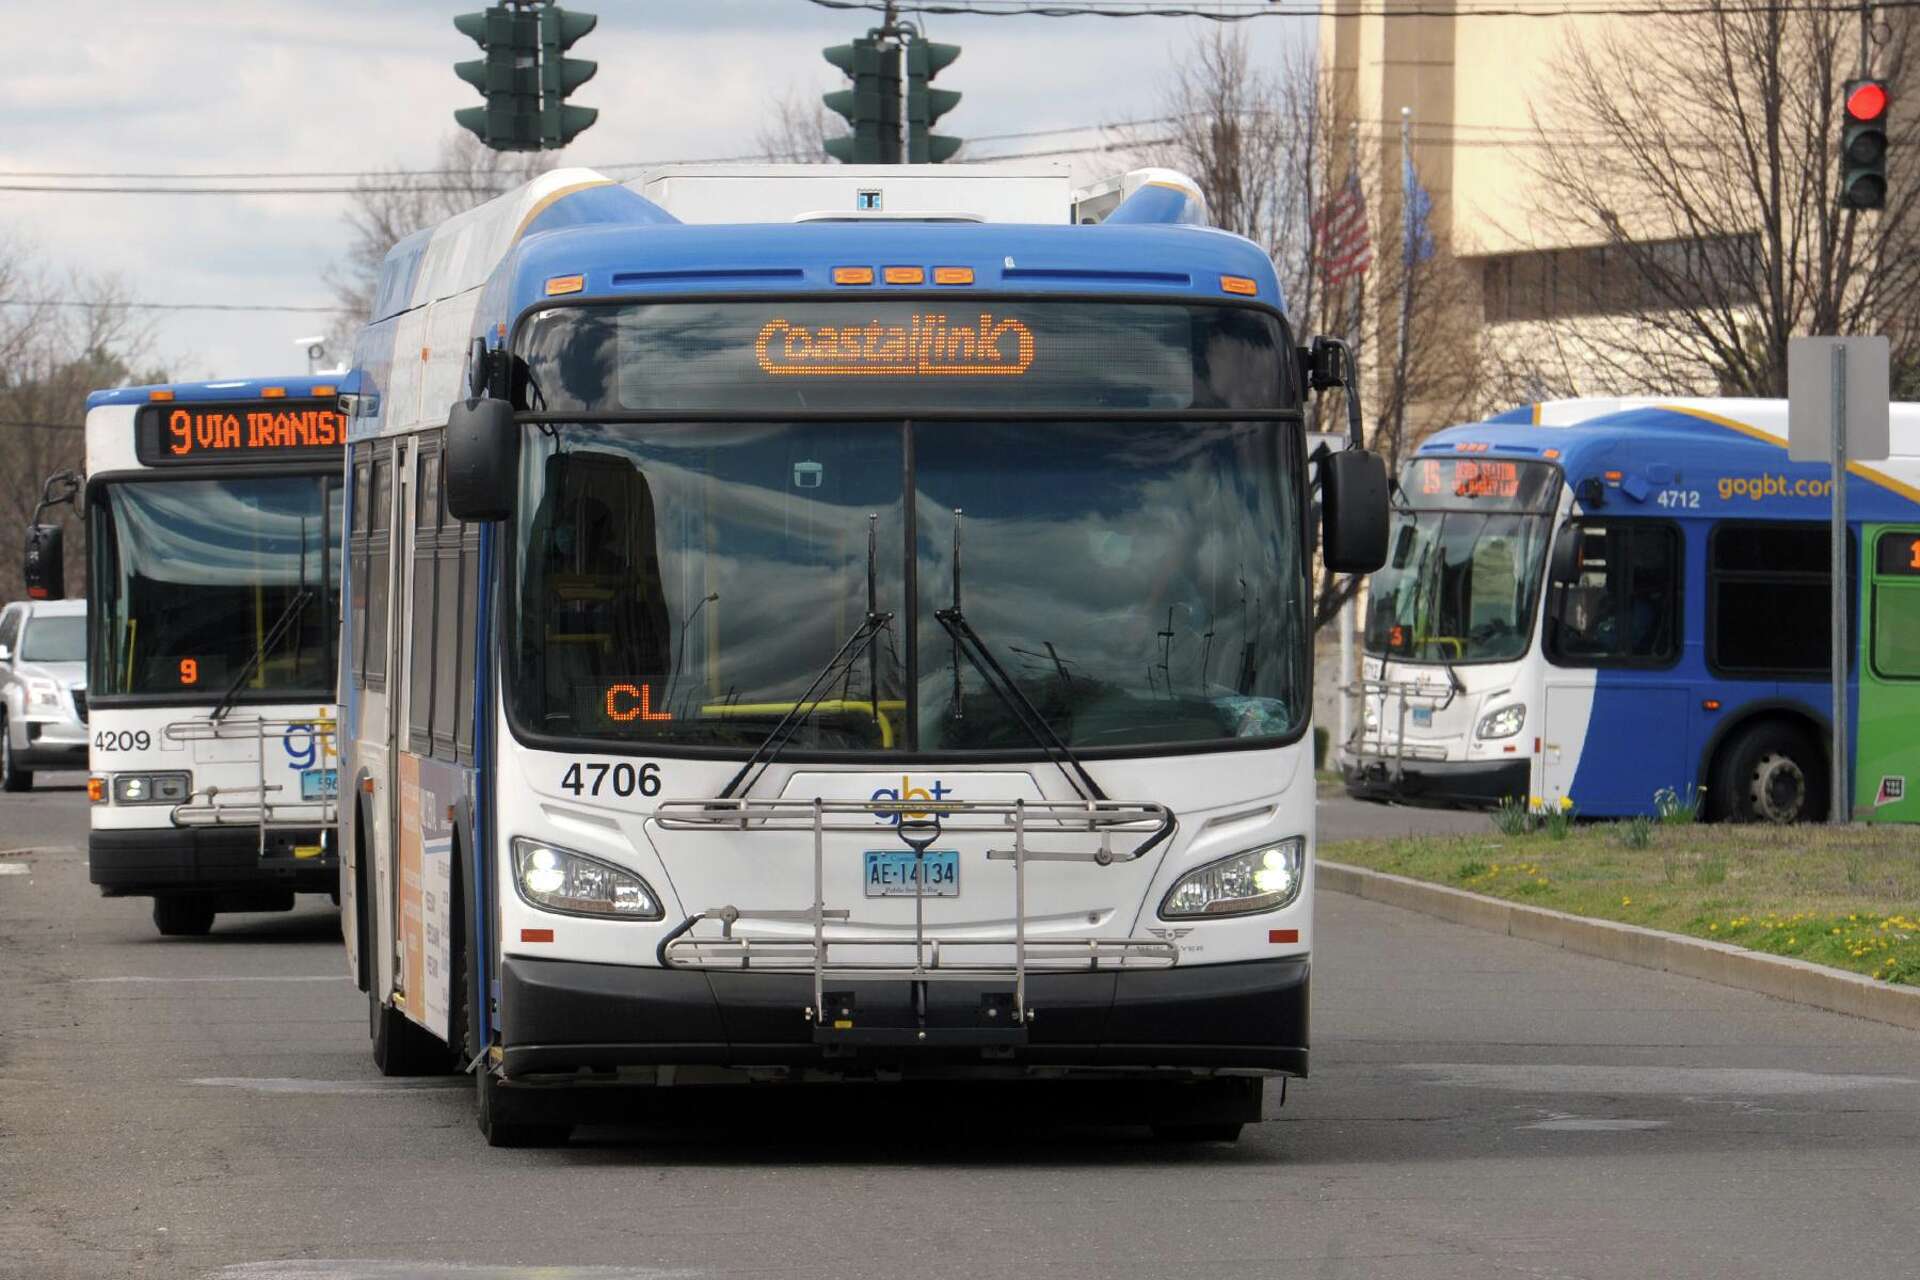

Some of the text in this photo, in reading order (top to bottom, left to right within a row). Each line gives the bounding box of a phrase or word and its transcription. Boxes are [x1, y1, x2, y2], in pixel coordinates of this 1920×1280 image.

[170, 410, 191, 455] 9
[196, 414, 240, 448] VIA
[1657, 490, 1700, 508] 4712
[180, 659, 197, 684] 9
[607, 684, 672, 720] CL
[94, 730, 151, 752] 4209
[561, 762, 662, 797] 4706
[870, 775, 952, 825] gbt
